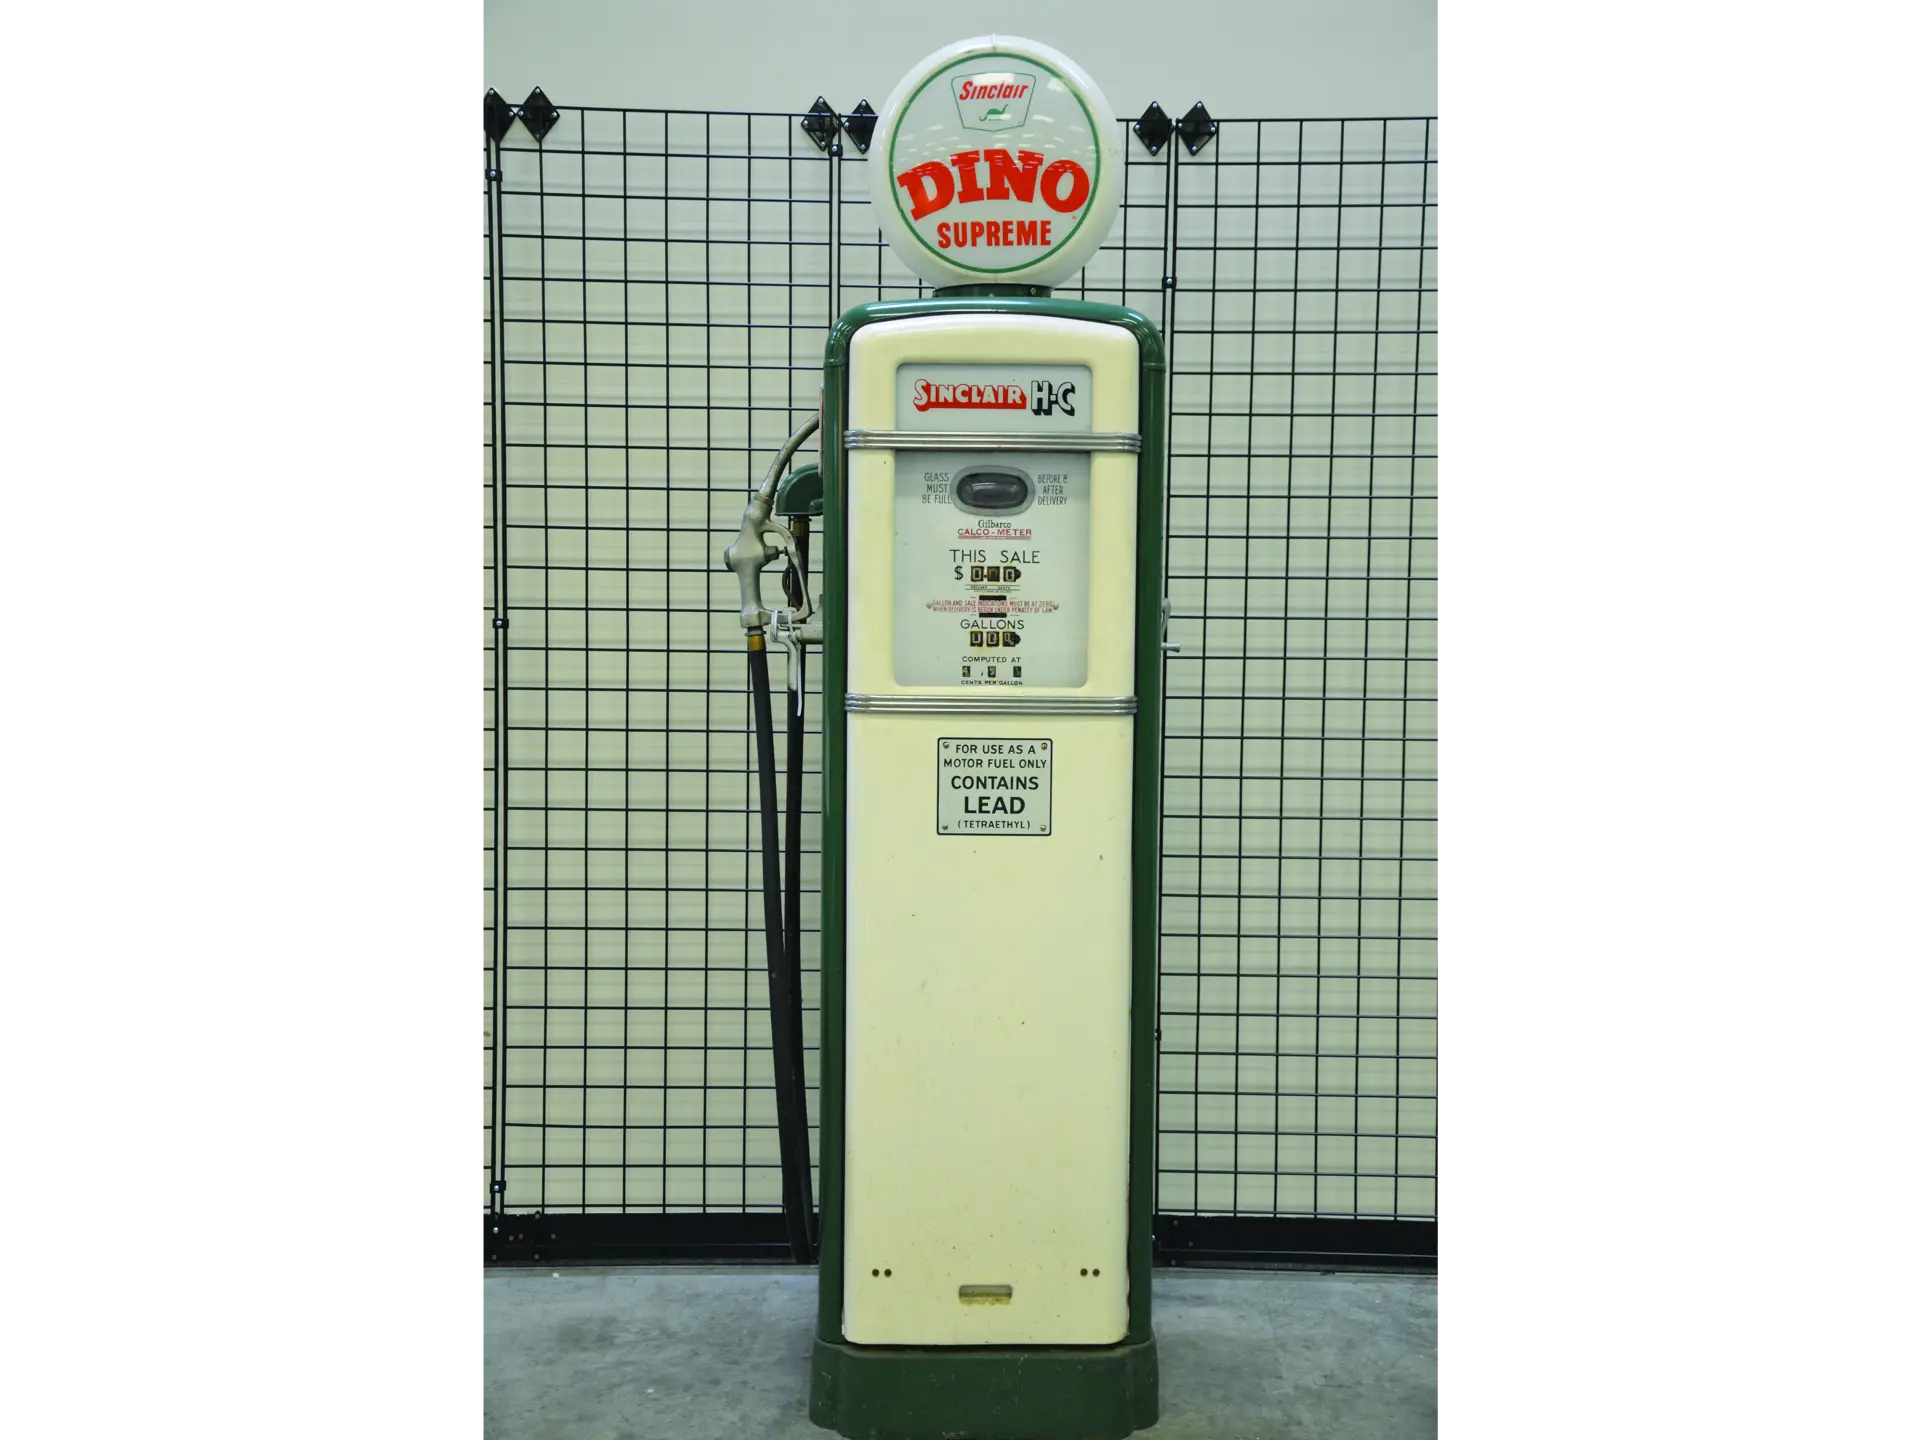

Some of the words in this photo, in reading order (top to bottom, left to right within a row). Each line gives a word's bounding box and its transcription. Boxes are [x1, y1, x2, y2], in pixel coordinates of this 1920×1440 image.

[959, 80, 1029, 100] Sinclair
[897, 148, 1090, 221] DINO
[937, 220, 1052, 249] SUPREME
[913, 379, 1027, 412] SINCLAIR
[1031, 380, 1076, 417] H-C
[924, 472, 949, 482] GLASS
[1037, 474, 1060, 484] BEFORE
[926, 483, 949, 493] MUST
[1042, 485, 1064, 495] AFTER
[922, 494, 931, 504] BE
[934, 494, 952, 504] FULL
[1037, 496, 1068, 506] DELIVERY
[977, 519, 1012, 529] Gilbarco
[949, 549, 987, 563] THIS
[999, 550, 1041, 564] SALE
[960, 619, 1025, 630] GALLONS
[961, 655, 1007, 663] COMPUTED
[955, 744, 978, 754] FOR
[982, 744, 1004, 754] USE
[1007, 744, 1023, 755] AS
[1027, 745, 1036, 755] A
[943, 758, 983, 768] MOTOR
[987, 759, 1015, 768] FUEL
[1019, 759, 1047, 769] ONLY
[951, 775, 1039, 790] CONTAINS
[964, 796, 1026, 815] LEAD
